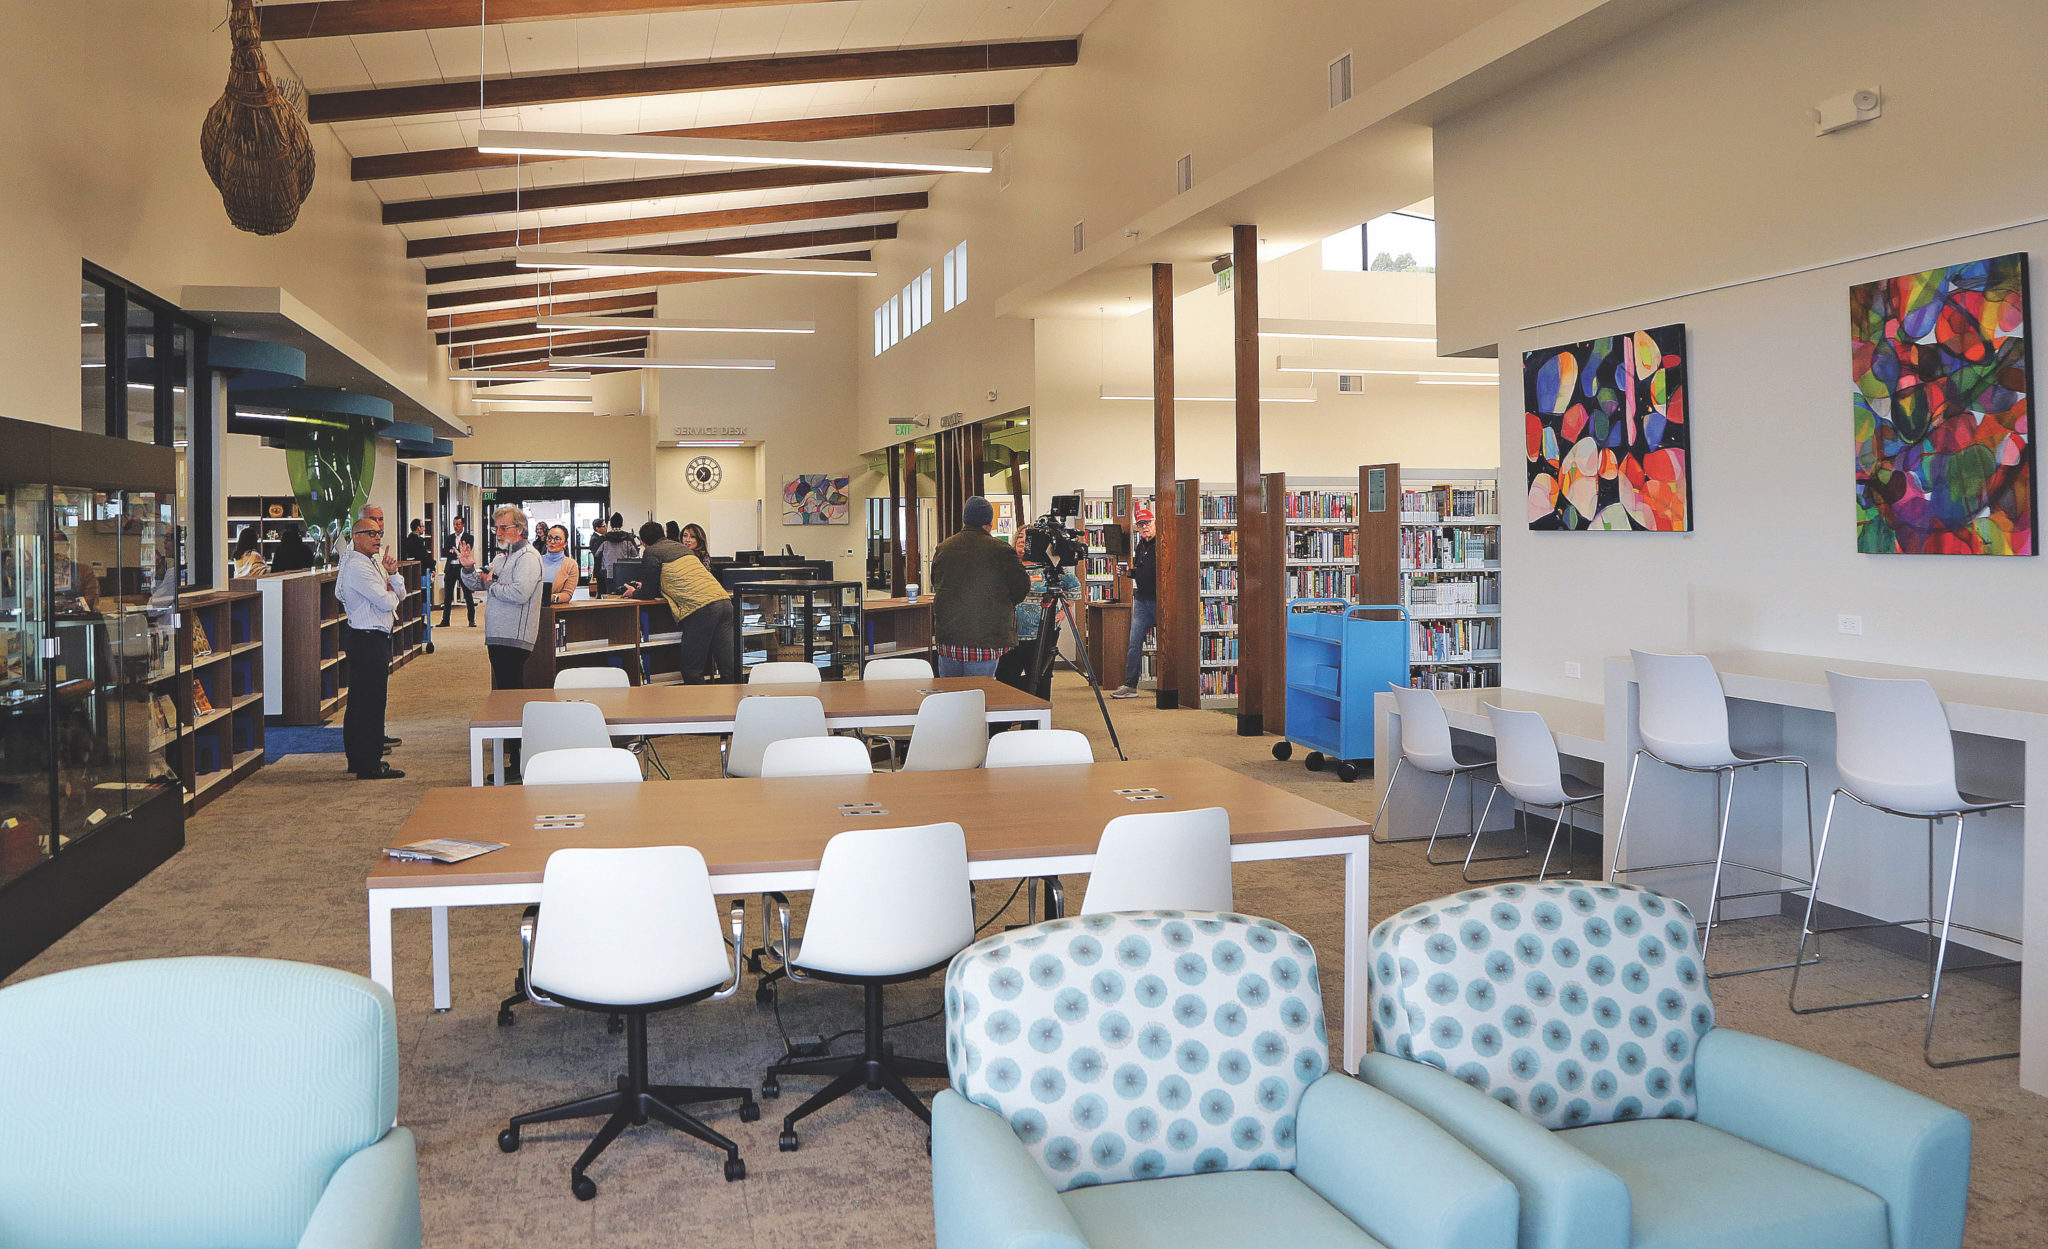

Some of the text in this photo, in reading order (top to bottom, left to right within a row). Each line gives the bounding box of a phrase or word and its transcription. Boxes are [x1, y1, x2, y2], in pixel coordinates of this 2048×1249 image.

[674, 425, 748, 436] SERVICE DESK
[896, 424, 912, 436] EXIT
